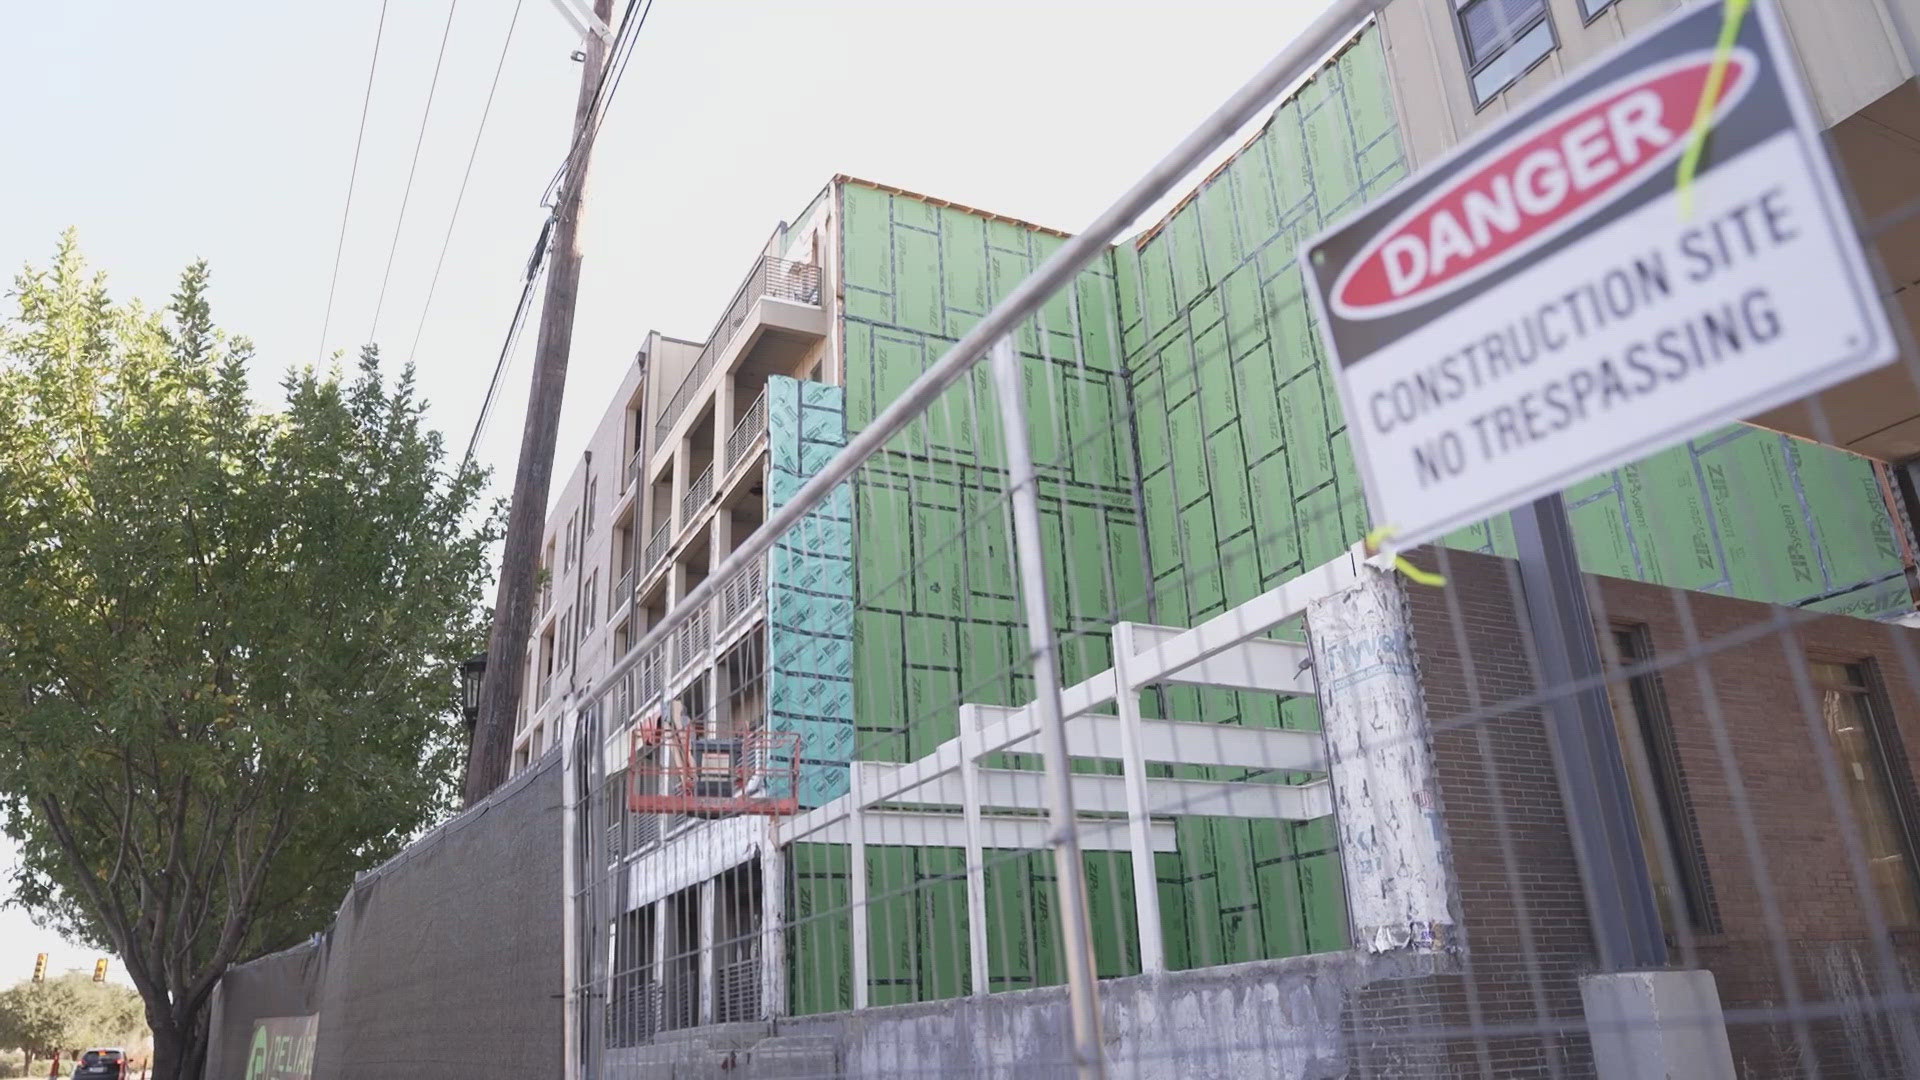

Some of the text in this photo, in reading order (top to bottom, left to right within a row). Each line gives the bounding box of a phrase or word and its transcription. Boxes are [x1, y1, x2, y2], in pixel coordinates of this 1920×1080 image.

[1380, 89, 1672, 296] DANGER
[1369, 186, 1797, 434] CONSTRUCTION SITE
[1410, 436, 1466, 490] NO
[1472, 289, 1782, 470] TRESPASSING
